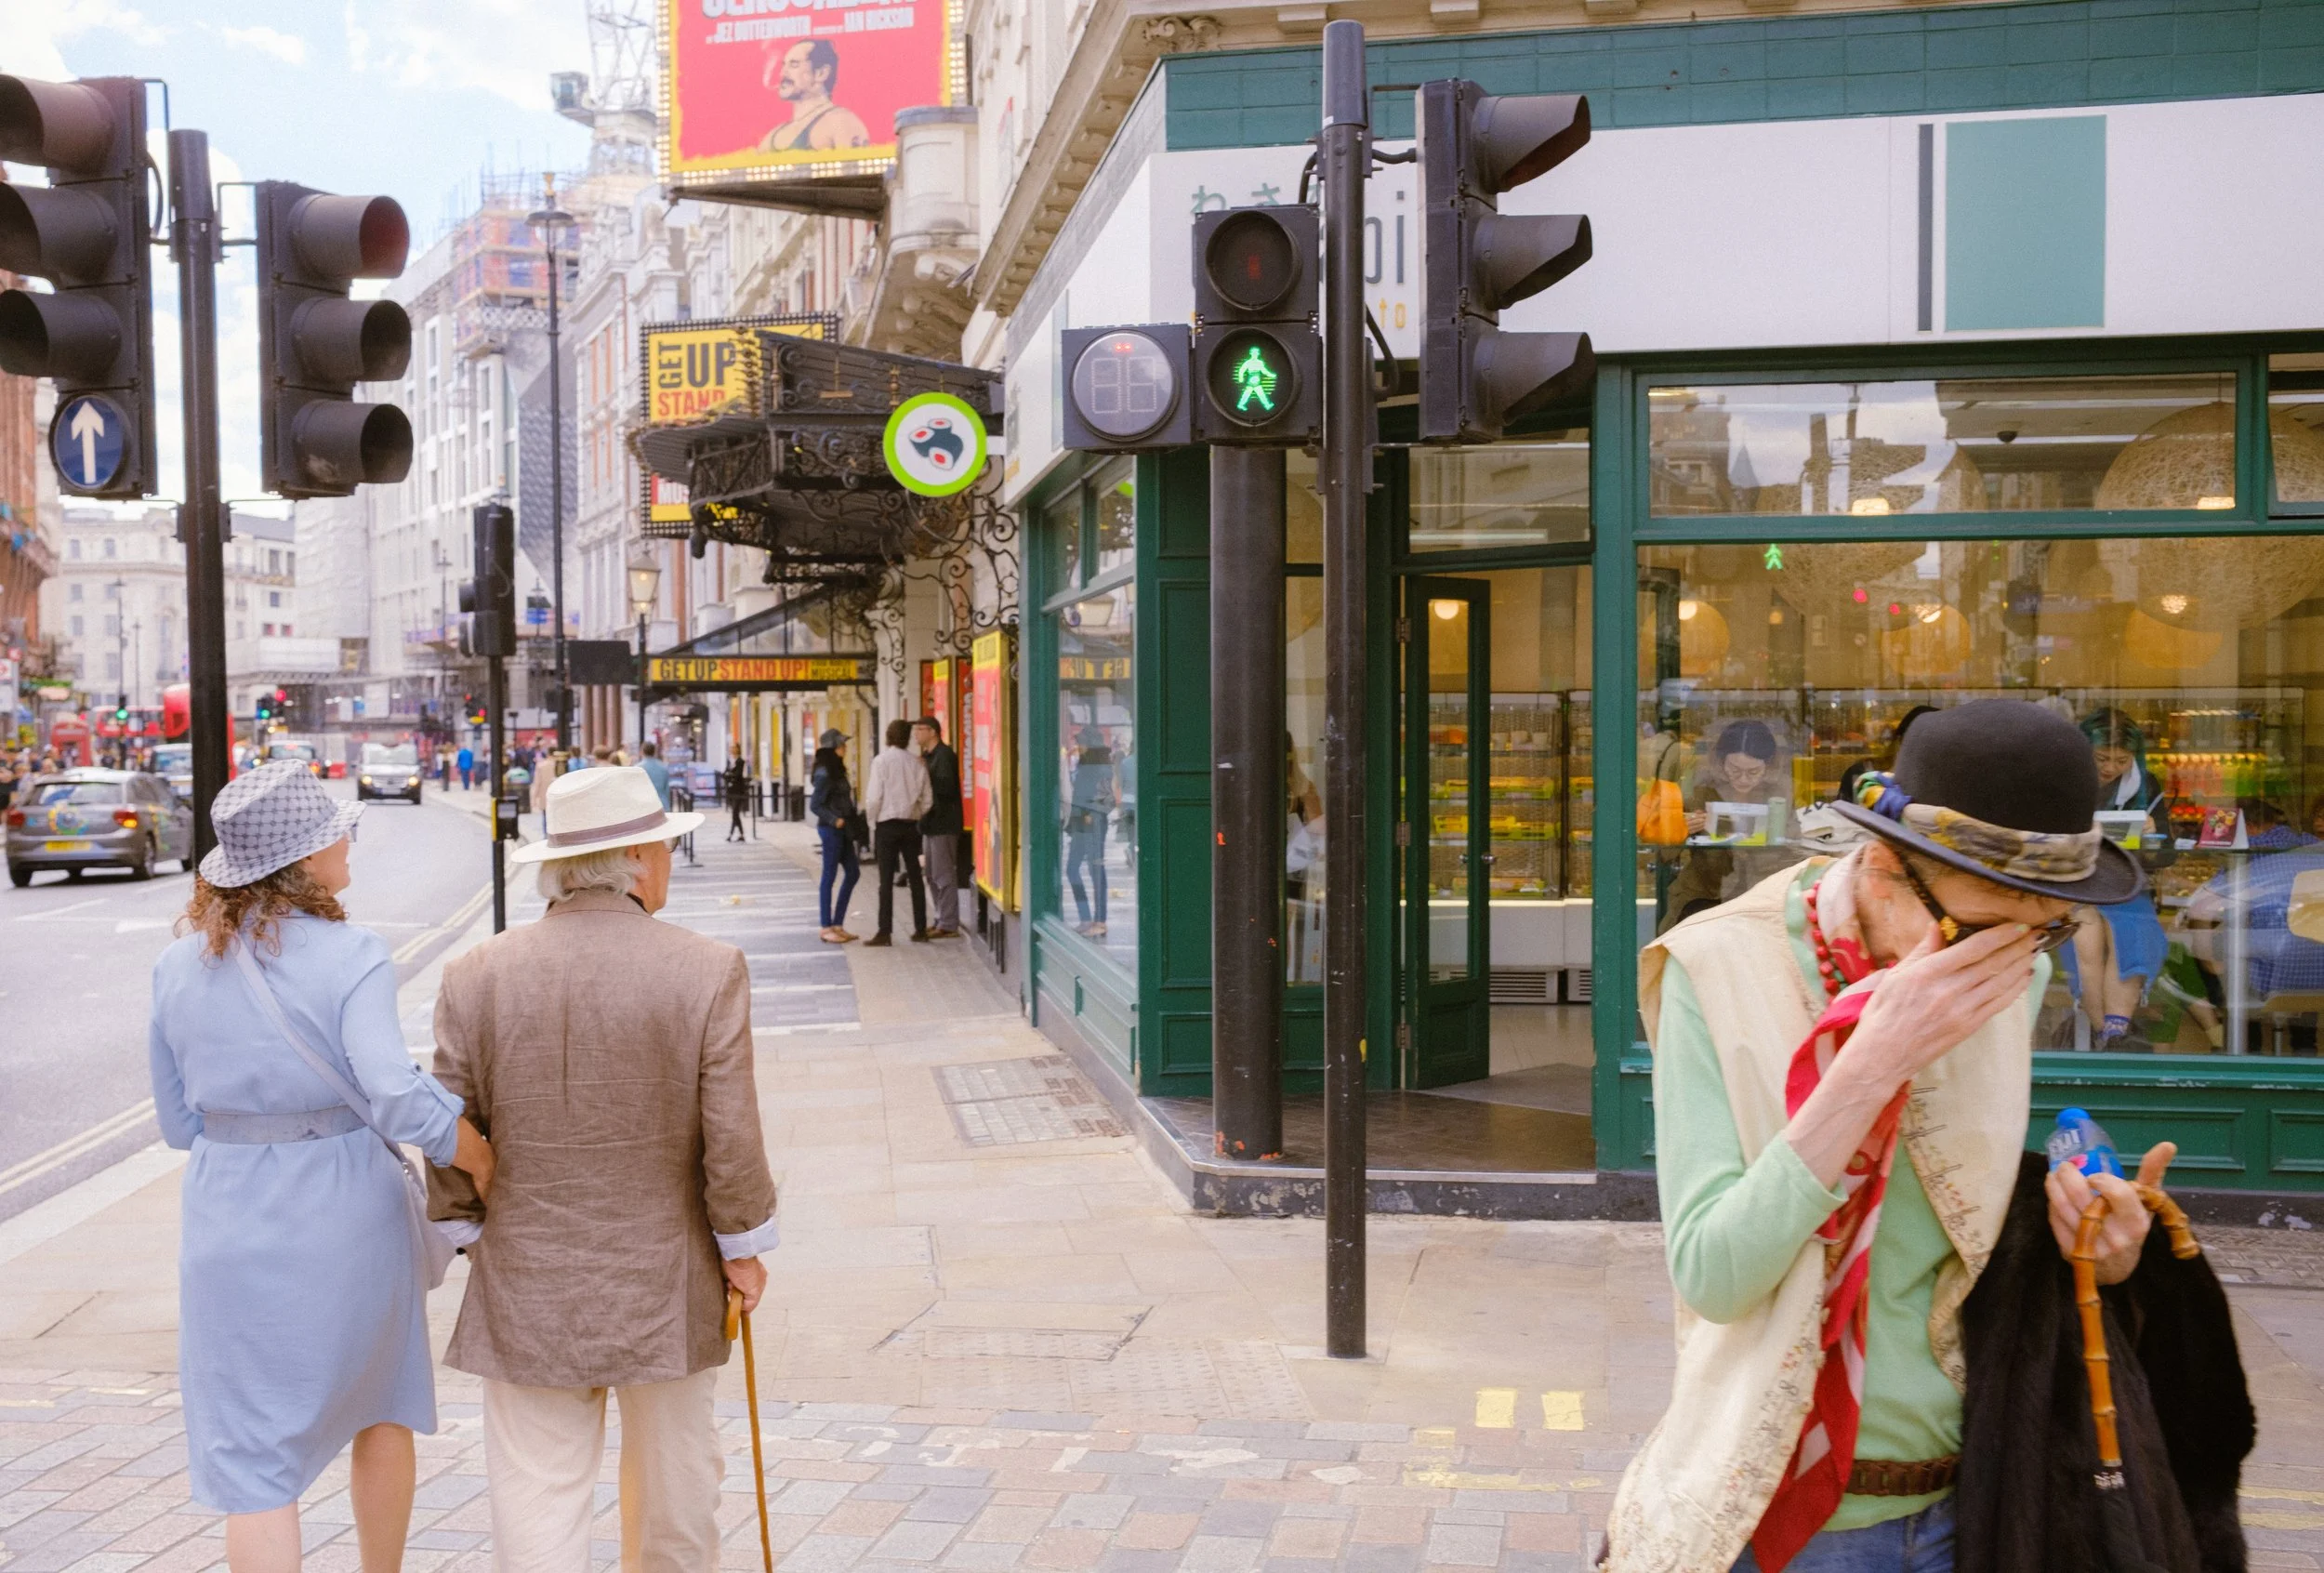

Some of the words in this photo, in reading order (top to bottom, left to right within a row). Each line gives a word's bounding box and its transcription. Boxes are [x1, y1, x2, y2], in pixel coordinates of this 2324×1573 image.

[658, 341, 682, 389] GET
[687, 342, 735, 388] UP
[660, 659, 692, 680] GET
[695, 659, 717, 680] UP
[720, 659, 775, 680] STAND
[780, 659, 811, 680] UP!
